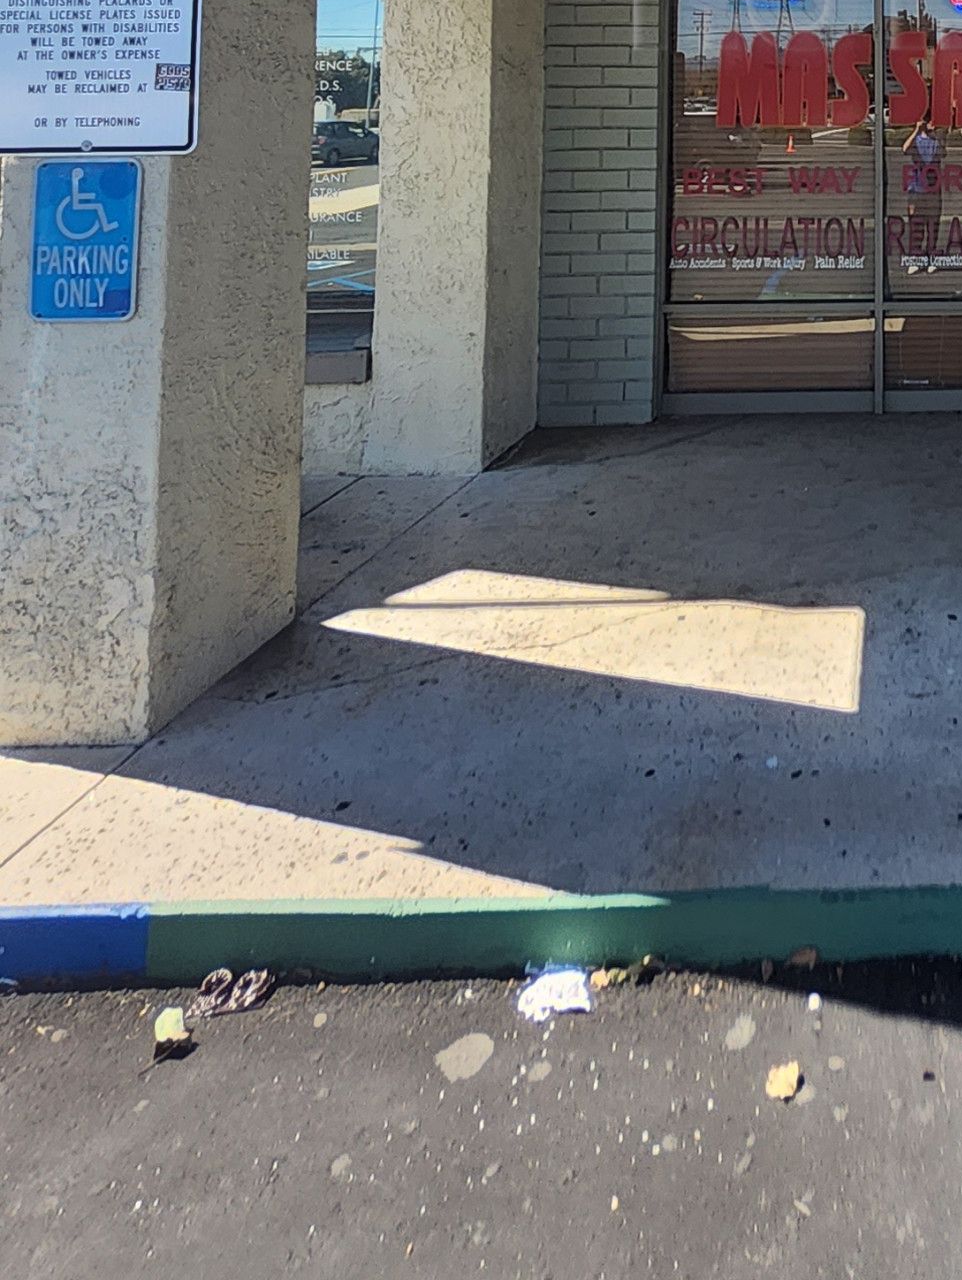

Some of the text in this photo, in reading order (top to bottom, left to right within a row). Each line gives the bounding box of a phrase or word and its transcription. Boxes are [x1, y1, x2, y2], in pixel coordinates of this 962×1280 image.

[0, 10, 181, 20] SPECIAL LICENSE PLATES ISSUED
[0, 22, 180, 34] FOR PERSONS WITH DISABILITIES
[30, 36, 148, 47] WILL BE TOWED AWAY
[17, 50, 160, 60] AT THE OWNER'S EXPENSE
[46, 70, 131, 81] TOWED VEHICLES
[28, 83, 148, 94] MAY BE RECLAIMED AT
[34, 116, 140, 128] OR BY TELEPHONING
[682, 167, 768, 196] BEST
[788, 166, 860, 195] WAY
[670, 214, 865, 258] CIRCULATION
[35, 244, 130, 276] PARKING
[814, 256, 836, 269] Pain
[837, 256, 866, 269] Relief
[54, 278, 110, 309] ONLY
